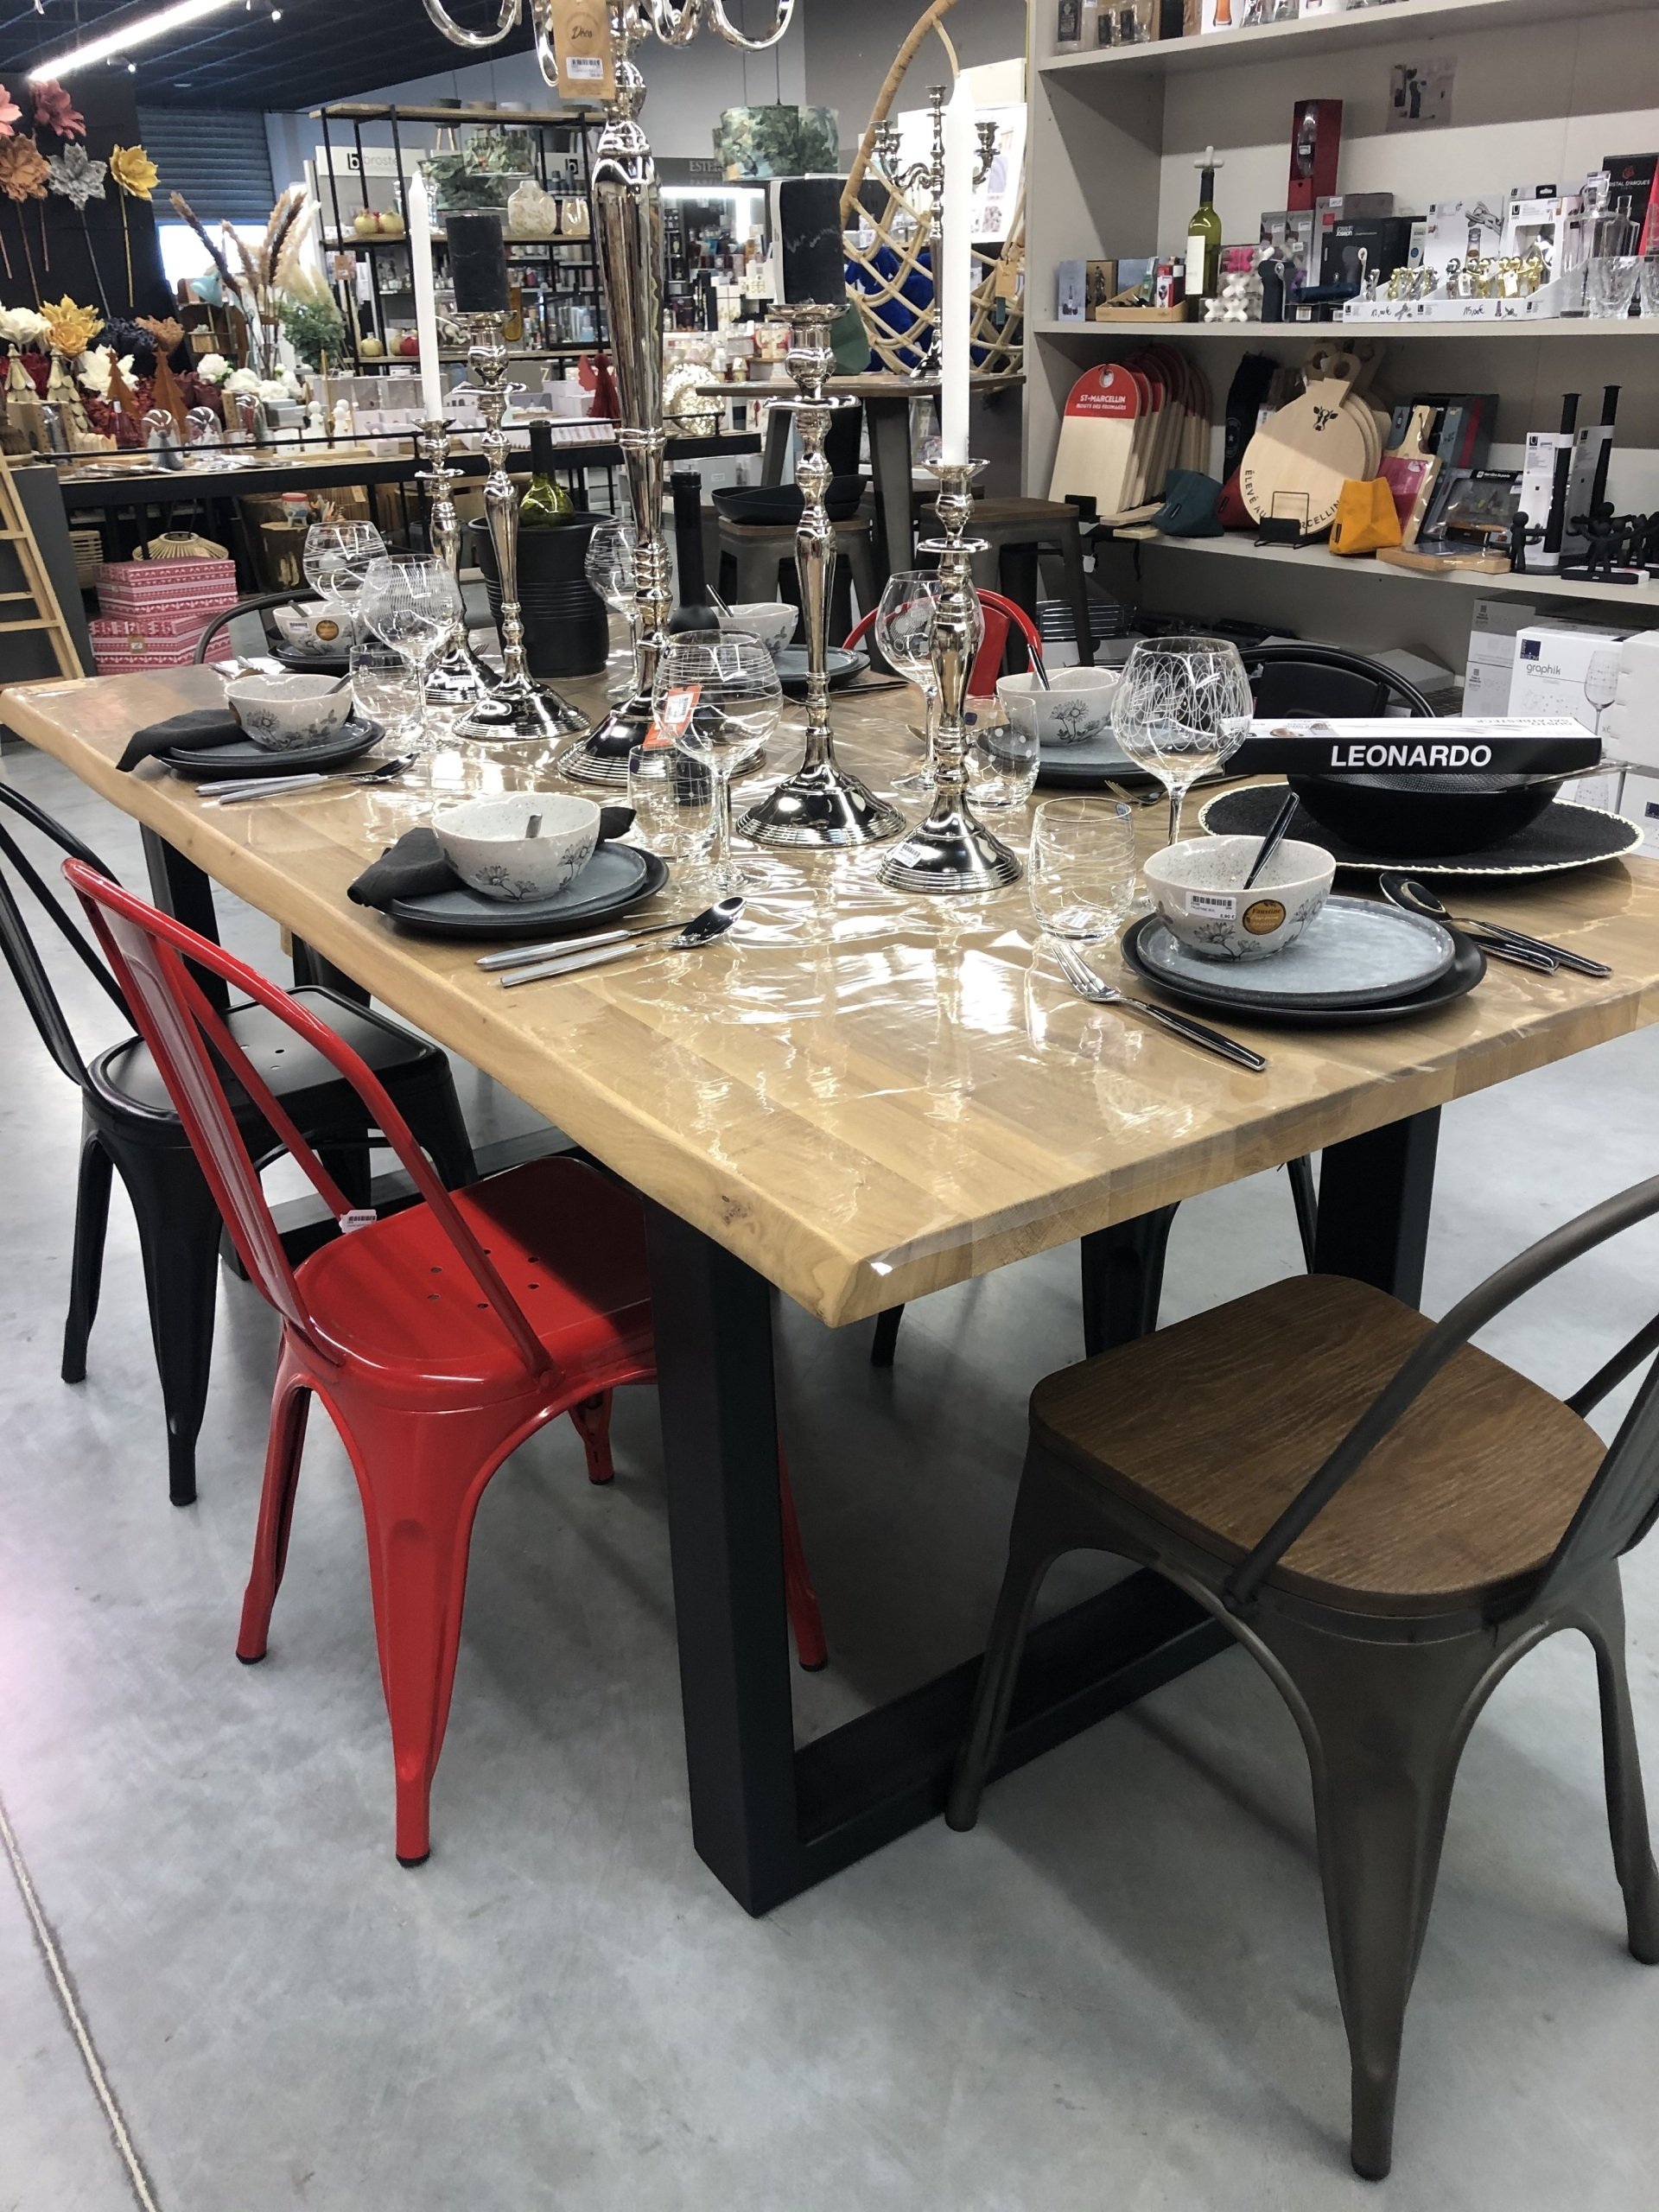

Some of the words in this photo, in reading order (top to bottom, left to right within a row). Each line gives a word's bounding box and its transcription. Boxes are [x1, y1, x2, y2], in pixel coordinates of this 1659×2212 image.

[1080, 394, 1126, 404] ST-MARCELLIN
[1244, 469, 1259, 504] ÉLEVÉ
[1526, 663, 1561, 676] graphik
[1331, 744, 1492, 767] LEONARDO
